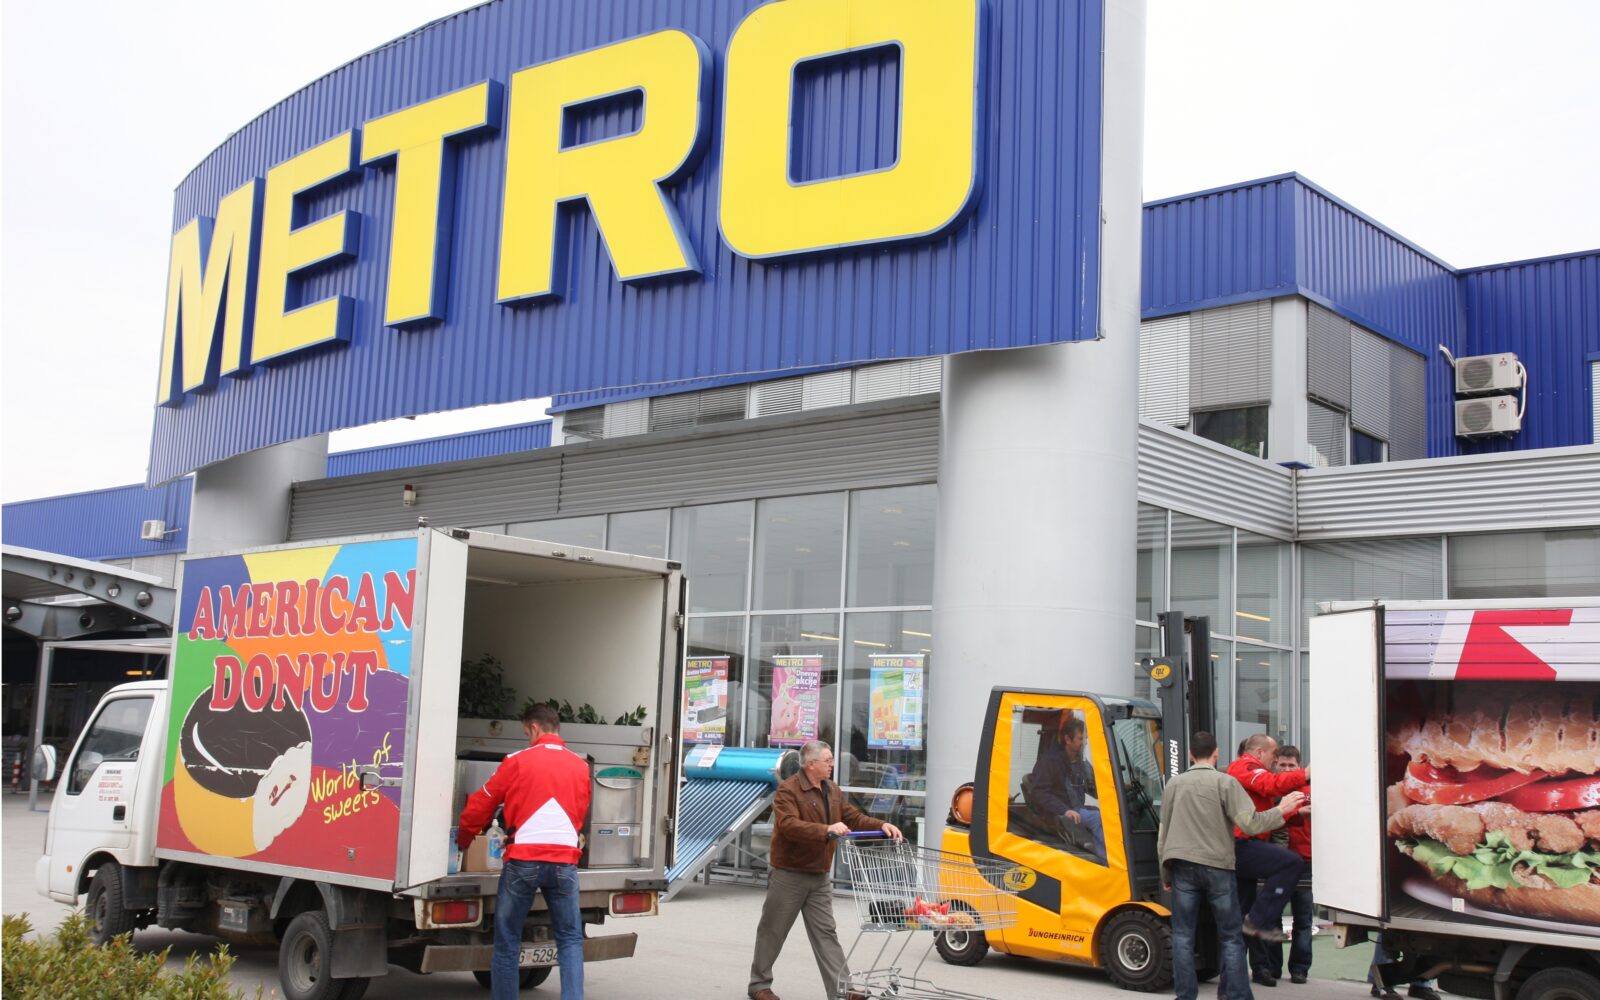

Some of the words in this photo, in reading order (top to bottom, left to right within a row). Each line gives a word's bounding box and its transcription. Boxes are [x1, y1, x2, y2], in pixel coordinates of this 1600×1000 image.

[157, 0, 983, 406] METRO
[188, 569, 416, 641] AMERICAN
[209, 650, 378, 713] DONUT
[687, 660, 713, 668] METRO
[796, 677, 817, 687] akcije
[873, 658, 903, 667] METRO
[311, 758, 360, 803] World
[373, 731, 392, 768] of
[323, 784, 380, 824] sweets
[1028, 928, 1085, 942] JUNGHEINRICH
